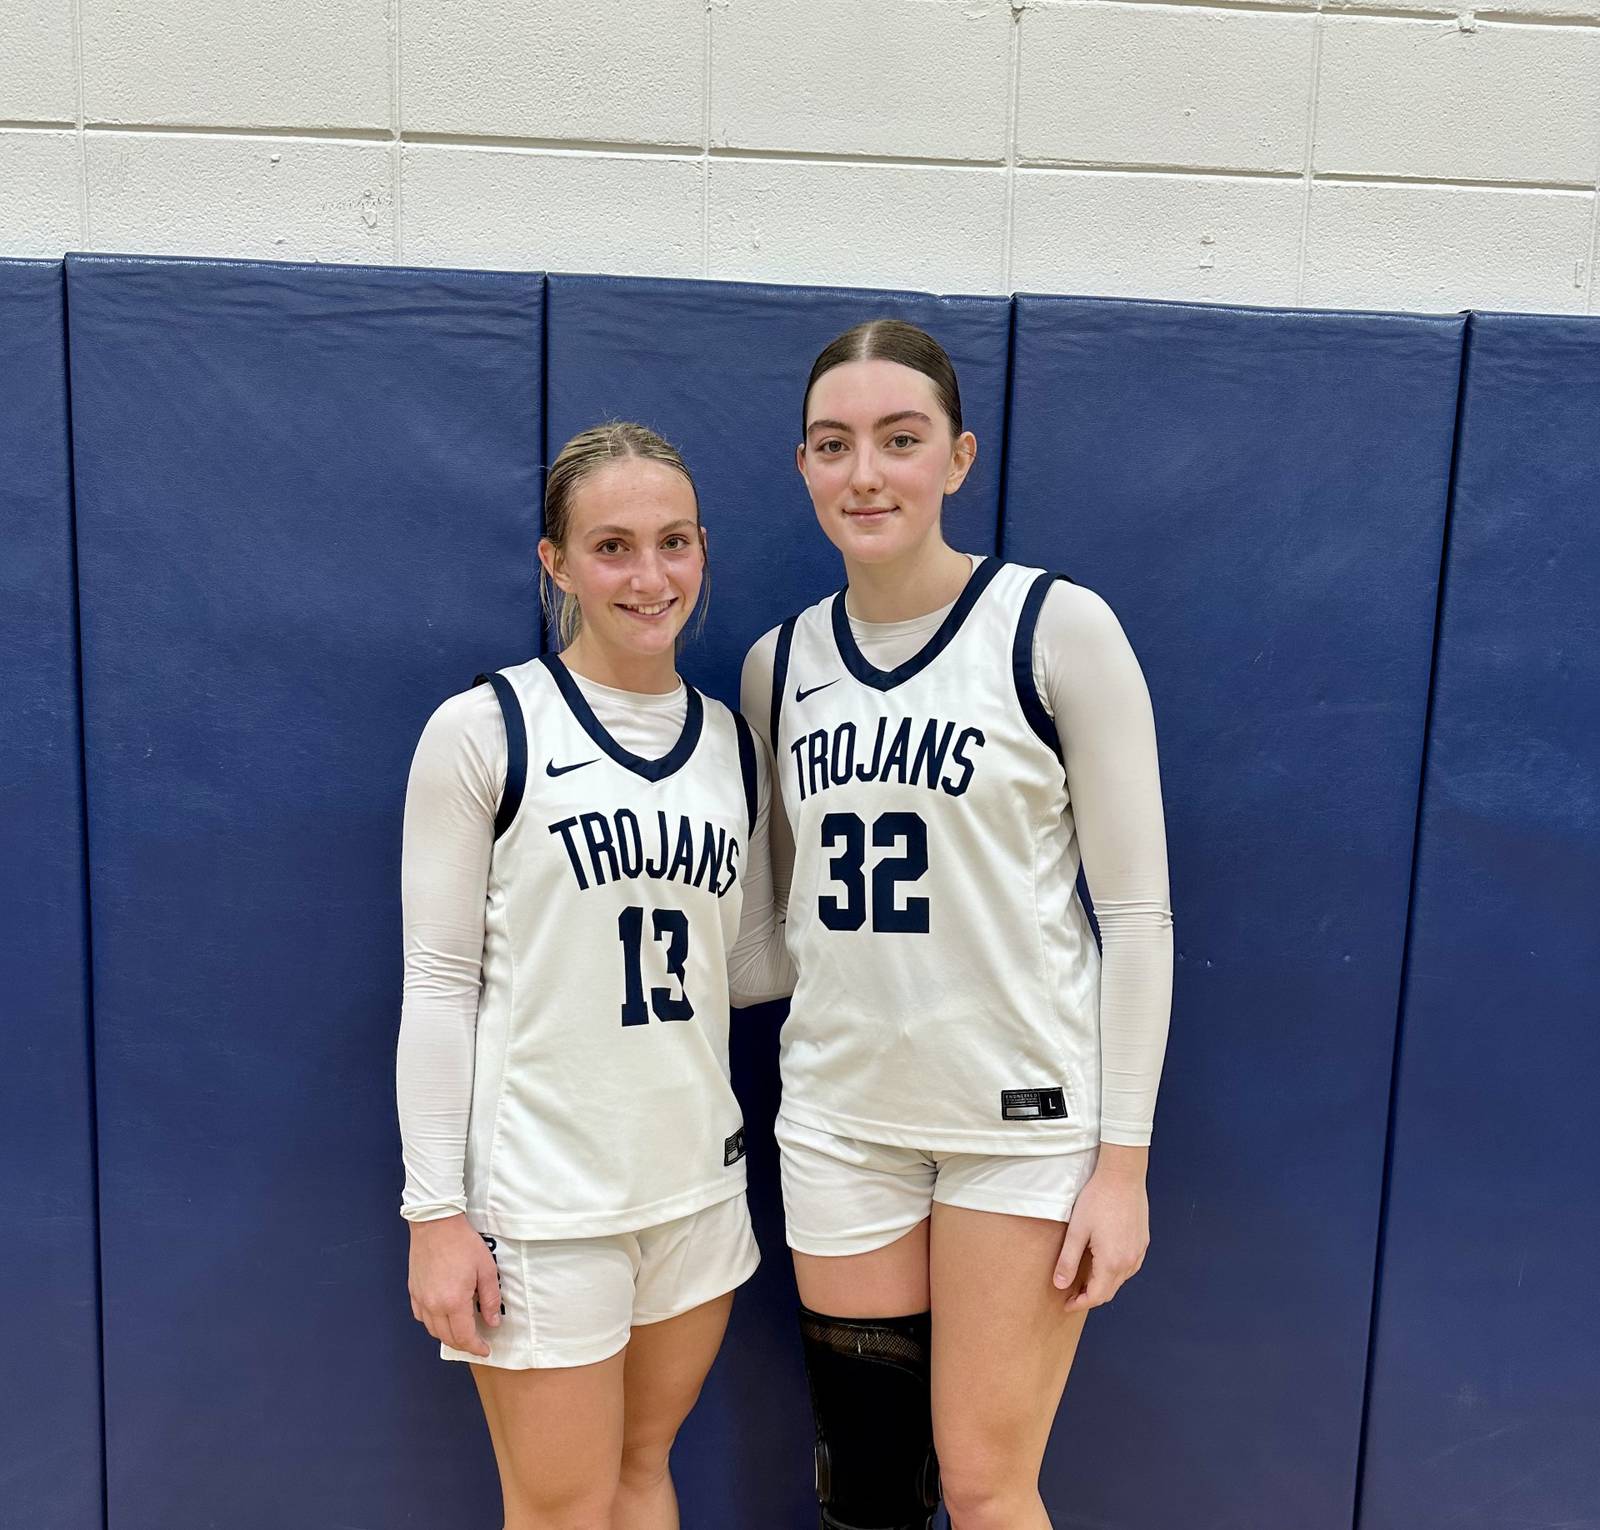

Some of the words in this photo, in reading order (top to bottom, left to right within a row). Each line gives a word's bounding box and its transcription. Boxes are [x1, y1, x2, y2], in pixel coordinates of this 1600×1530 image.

[791, 716, 985, 801] TROJANS
[548, 808, 739, 898] TROJANS
[818, 812, 930, 933] 32
[618, 906, 694, 1027] 13
[1048, 1097, 1056, 1110] L
